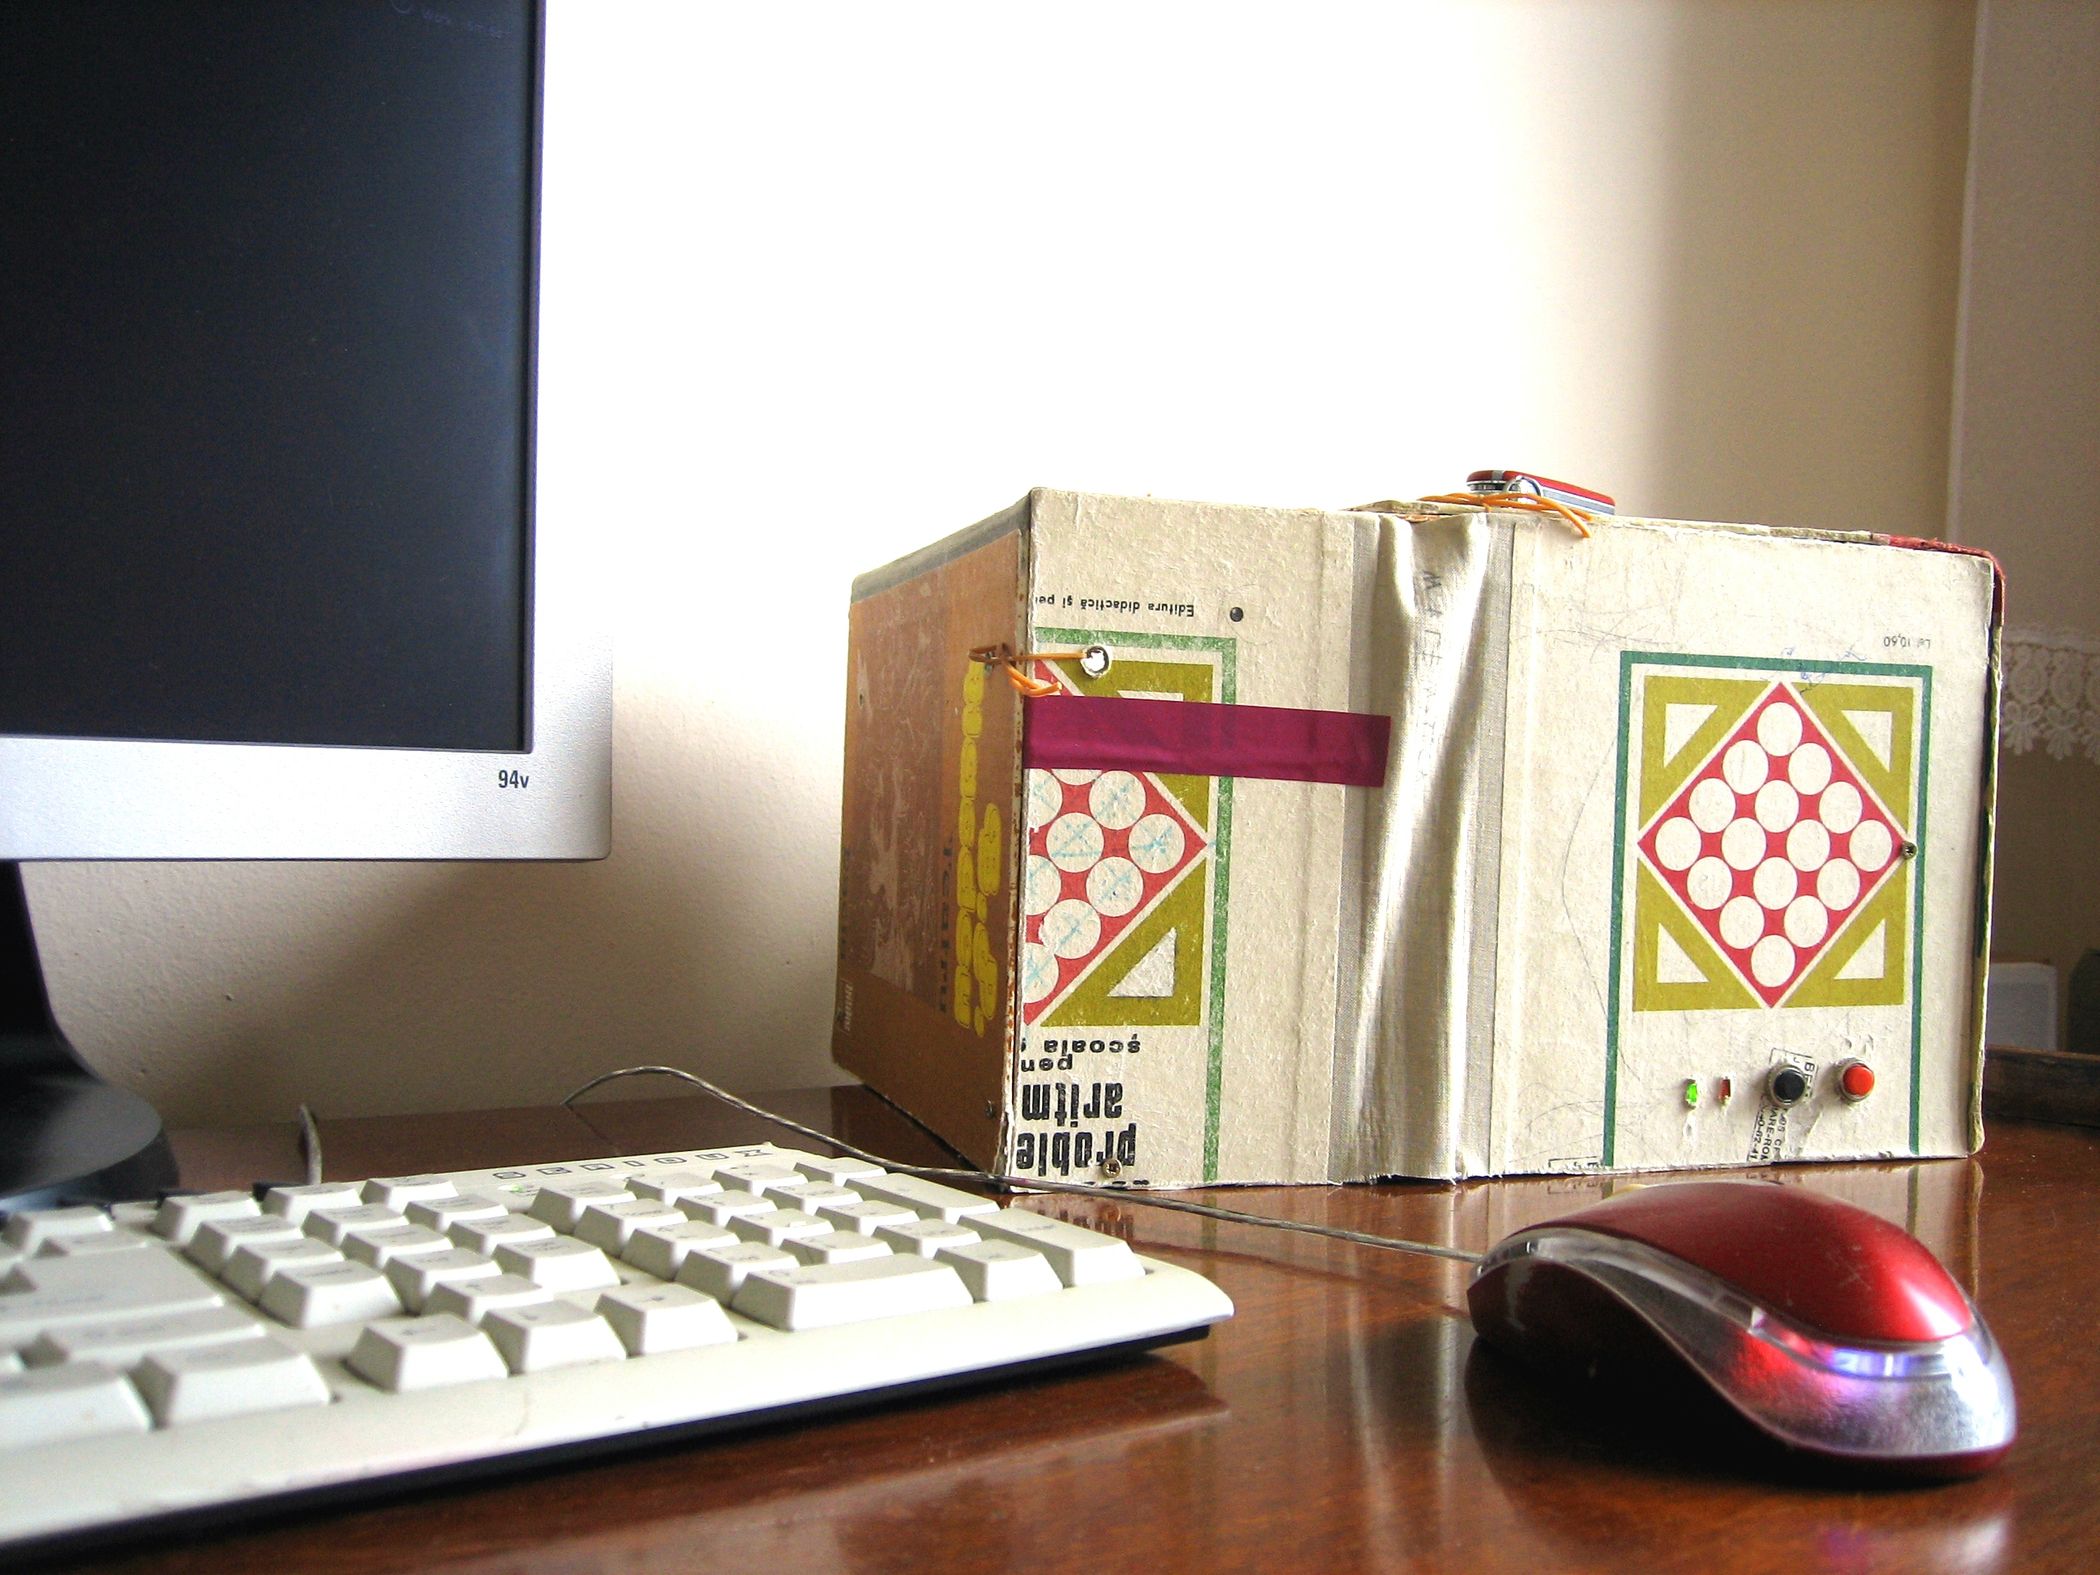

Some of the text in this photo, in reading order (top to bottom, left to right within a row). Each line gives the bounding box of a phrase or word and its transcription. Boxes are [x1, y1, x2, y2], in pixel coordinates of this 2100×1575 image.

[1035, 594, 1055, 605] pe
[1080, 598, 1140, 614] didactică
[1147, 603, 1195, 617] Editura
[1883, 633, 1911, 648] 10,60
[498, 769, 529, 789] 94v
[1021, 1082, 1123, 1128] aritm
[1015, 1122, 1137, 1177] proble
